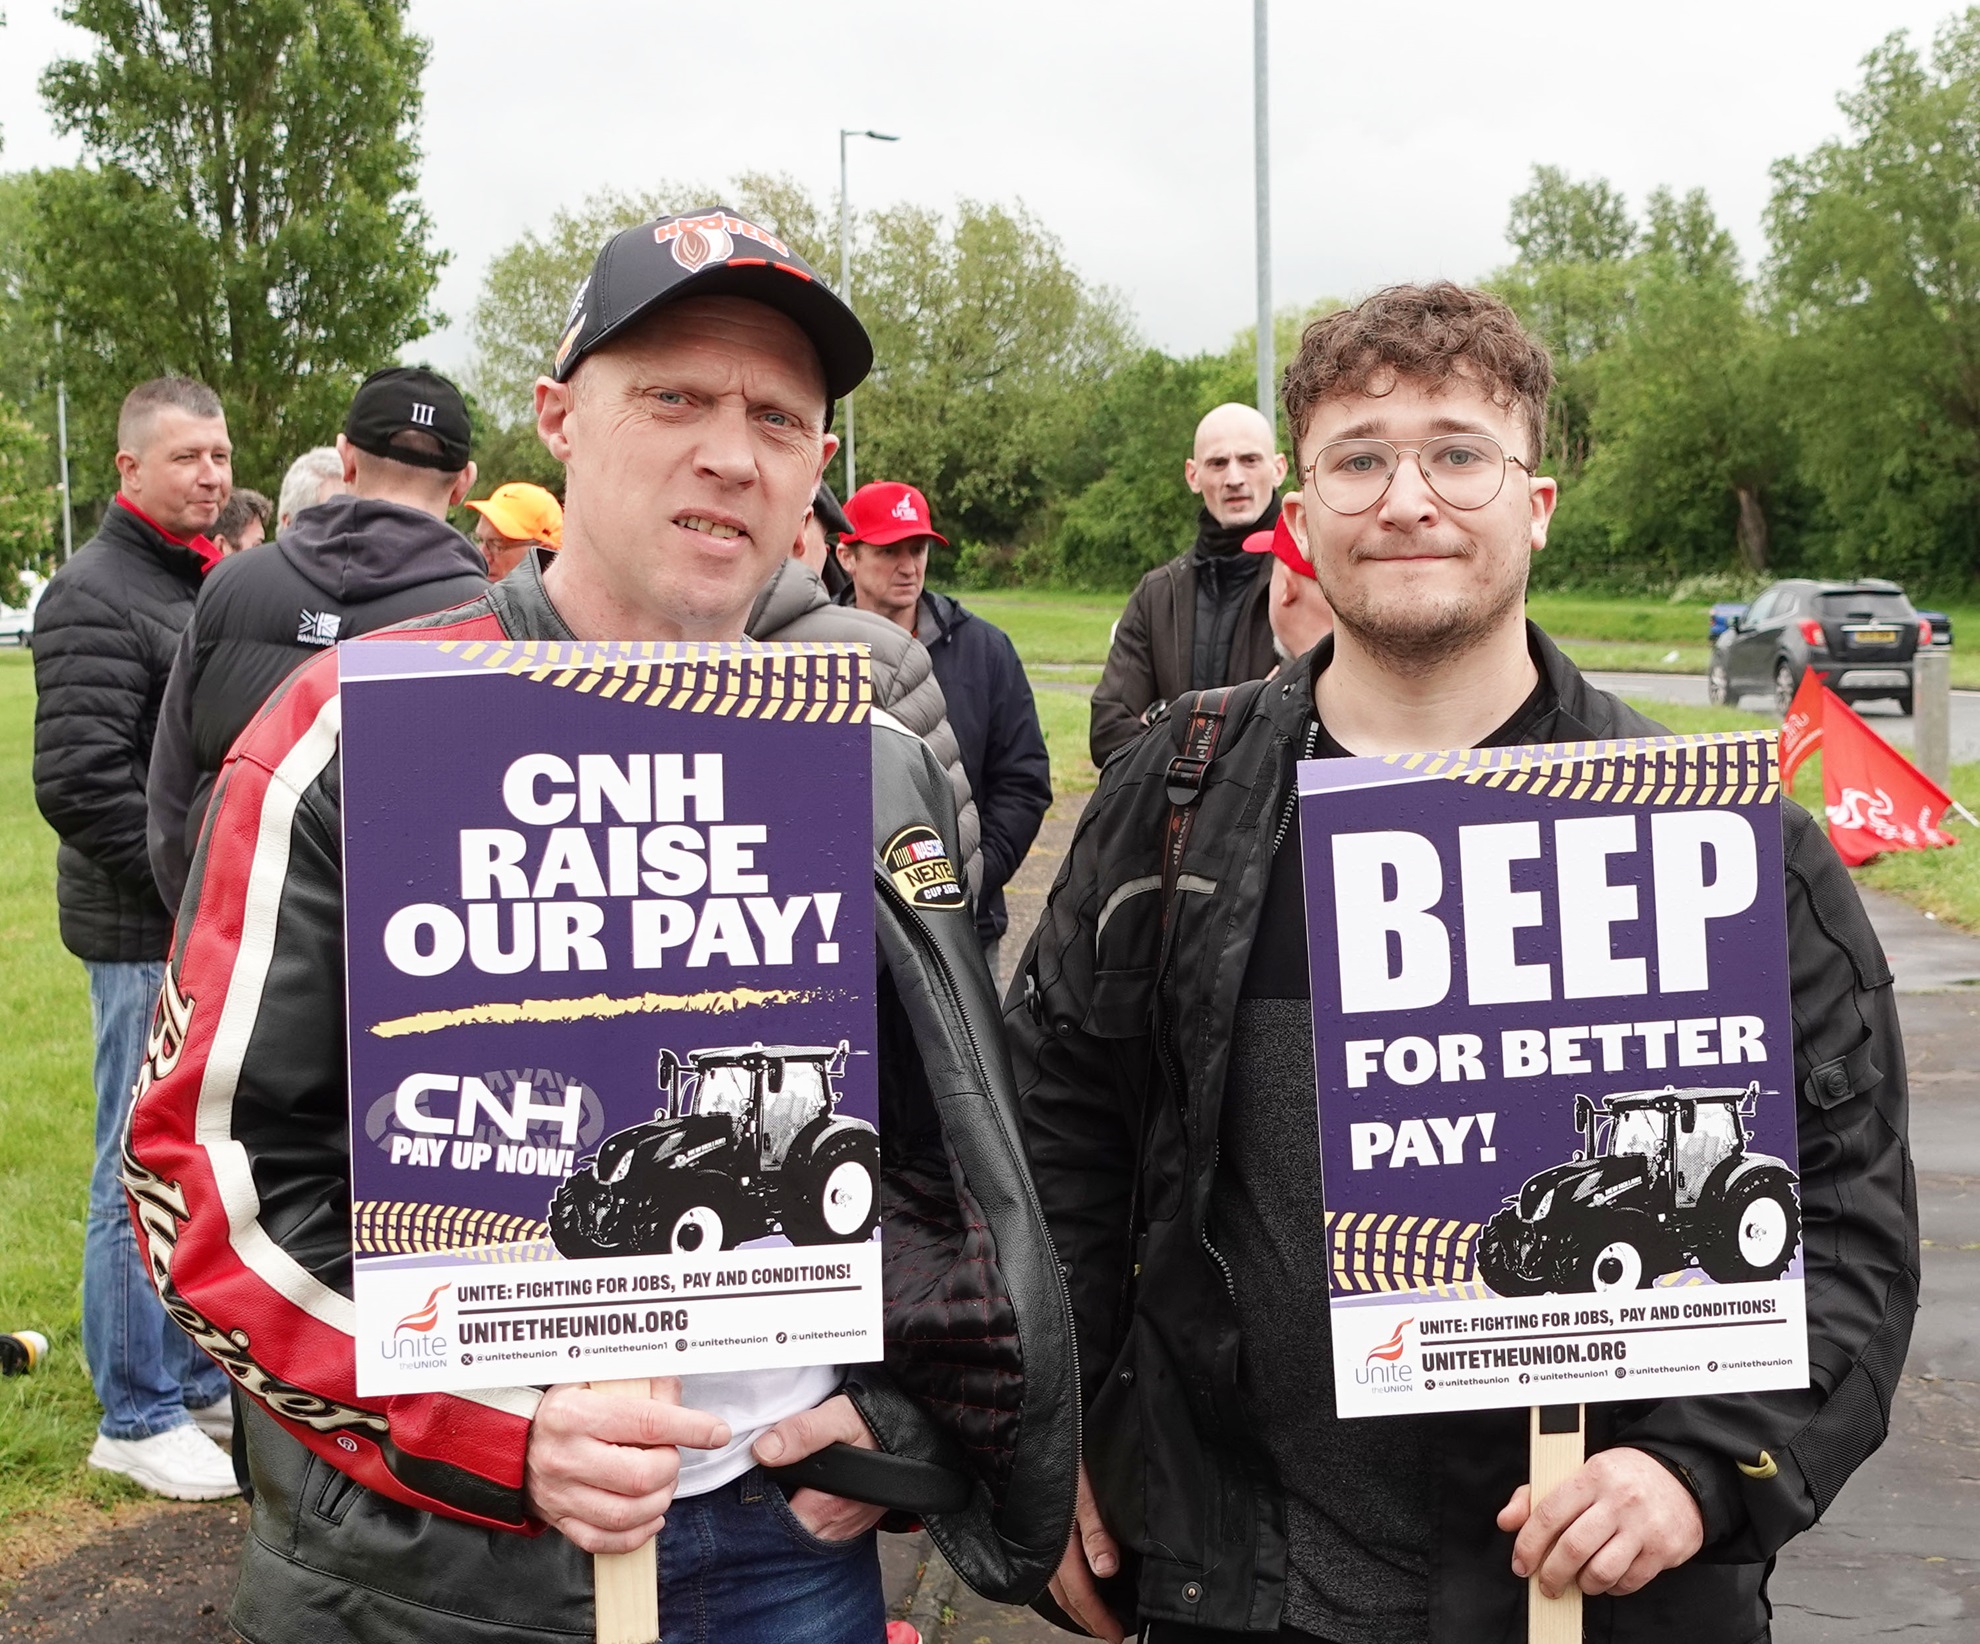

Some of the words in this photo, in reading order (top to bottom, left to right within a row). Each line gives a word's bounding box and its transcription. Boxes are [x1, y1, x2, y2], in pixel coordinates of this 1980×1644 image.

[655, 211, 788, 257] HOOTERS
[502, 753, 724, 825] CNH
[460, 824, 769, 900] RAISE
[904, 861, 954, 888] NEXTE
[923, 888, 942, 900] CUP
[1331, 810, 1758, 1014] BEEP
[383, 902, 608, 977] OUR
[632, 892, 841, 969] PAY!
[1345, 1034, 1486, 1088] FOR
[1501, 1015, 1767, 1079] BETTER
[395, 1072, 582, 1145] CNH
[391, 1135, 448, 1167] PAY
[452, 1140, 492, 1170] UP
[496, 1144, 575, 1177] NOW!
[1350, 1112, 1497, 1171] PAY!
[458, 1283, 512, 1302] UNITE:
[517, 1278, 592, 1299] FIGHTING
[597, 1276, 627, 1294] FOR
[632, 1274, 676, 1293] JOBS,
[683, 1271, 711, 1288] PAY
[716, 1269, 747, 1286] AND
[752, 1263, 851, 1285] CONDITIONS!
[459, 1309, 688, 1344] UNITETHEUNION.ORG
[1420, 1318, 1468, 1335] UNITE:
[1471, 1314, 1538, 1332] FIGHTING
[1542, 1312, 1570, 1327] FOR
[1574, 1309, 1614, 1326] JOBS,
[1620, 1307, 1646, 1322] PAY
[1650, 1305, 1679, 1320] AND
[1683, 1299, 1776, 1318] CONDITIONS!
[381, 1334, 447, 1360] unite
[1422, 1340, 1627, 1372] UNITETHEUNION.ORG
[1355, 1362, 1412, 1385] unite
